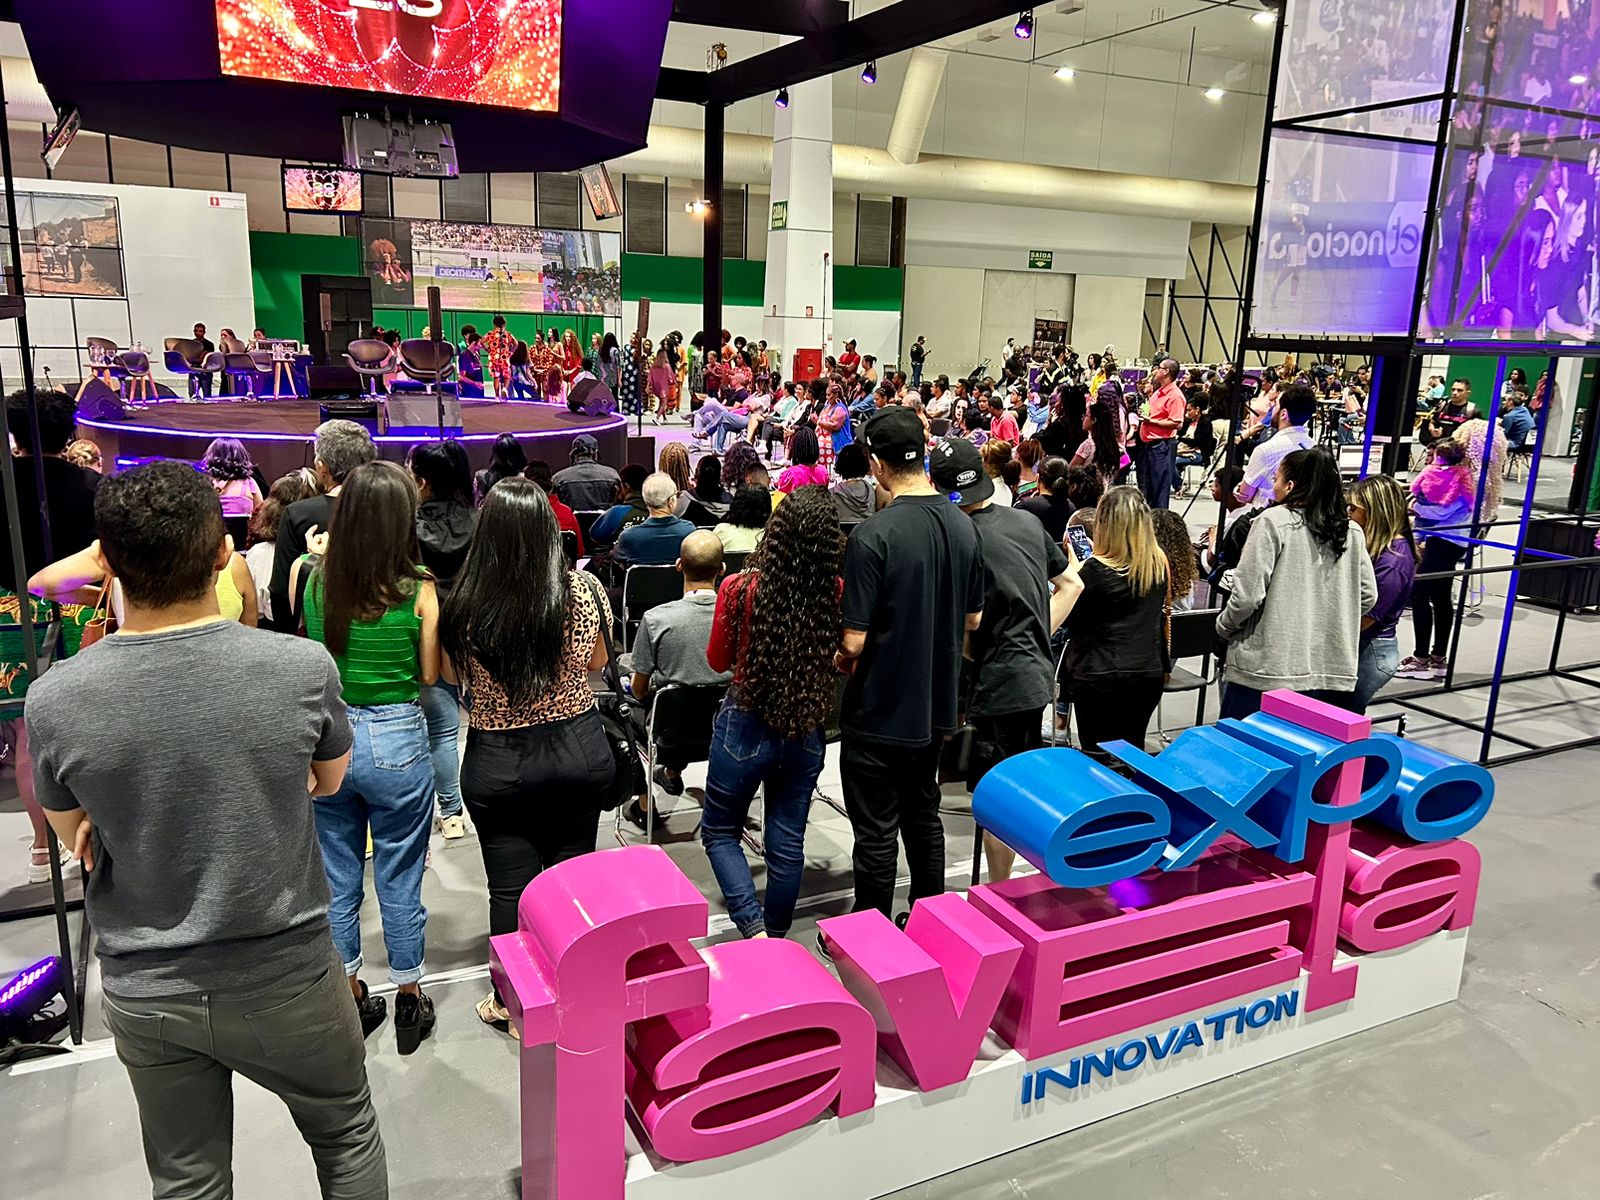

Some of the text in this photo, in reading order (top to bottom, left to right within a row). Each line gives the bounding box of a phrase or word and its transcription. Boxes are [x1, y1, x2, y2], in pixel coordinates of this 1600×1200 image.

[439, 268, 484, 279] DECATHLON
[971, 711, 1495, 888] expo
[1021, 989, 1300, 1104] INNOVATION
